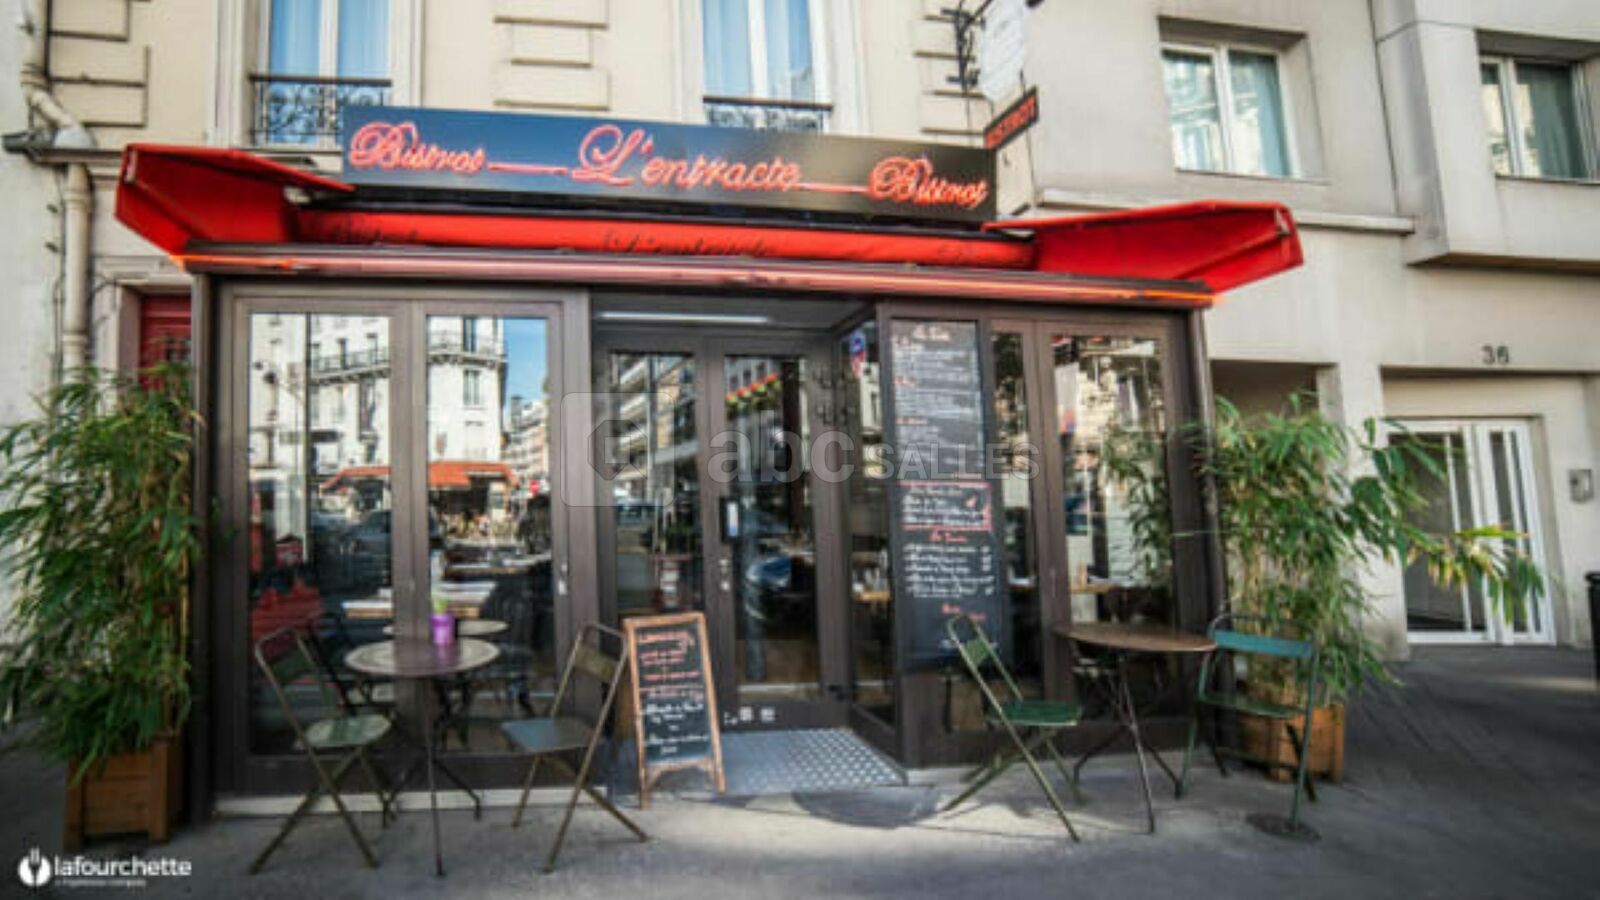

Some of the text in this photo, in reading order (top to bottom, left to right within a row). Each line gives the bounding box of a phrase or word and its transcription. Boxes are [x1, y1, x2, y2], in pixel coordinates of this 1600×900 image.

[349, 121, 988, 208] Bistrot L'entracte Bistrot
